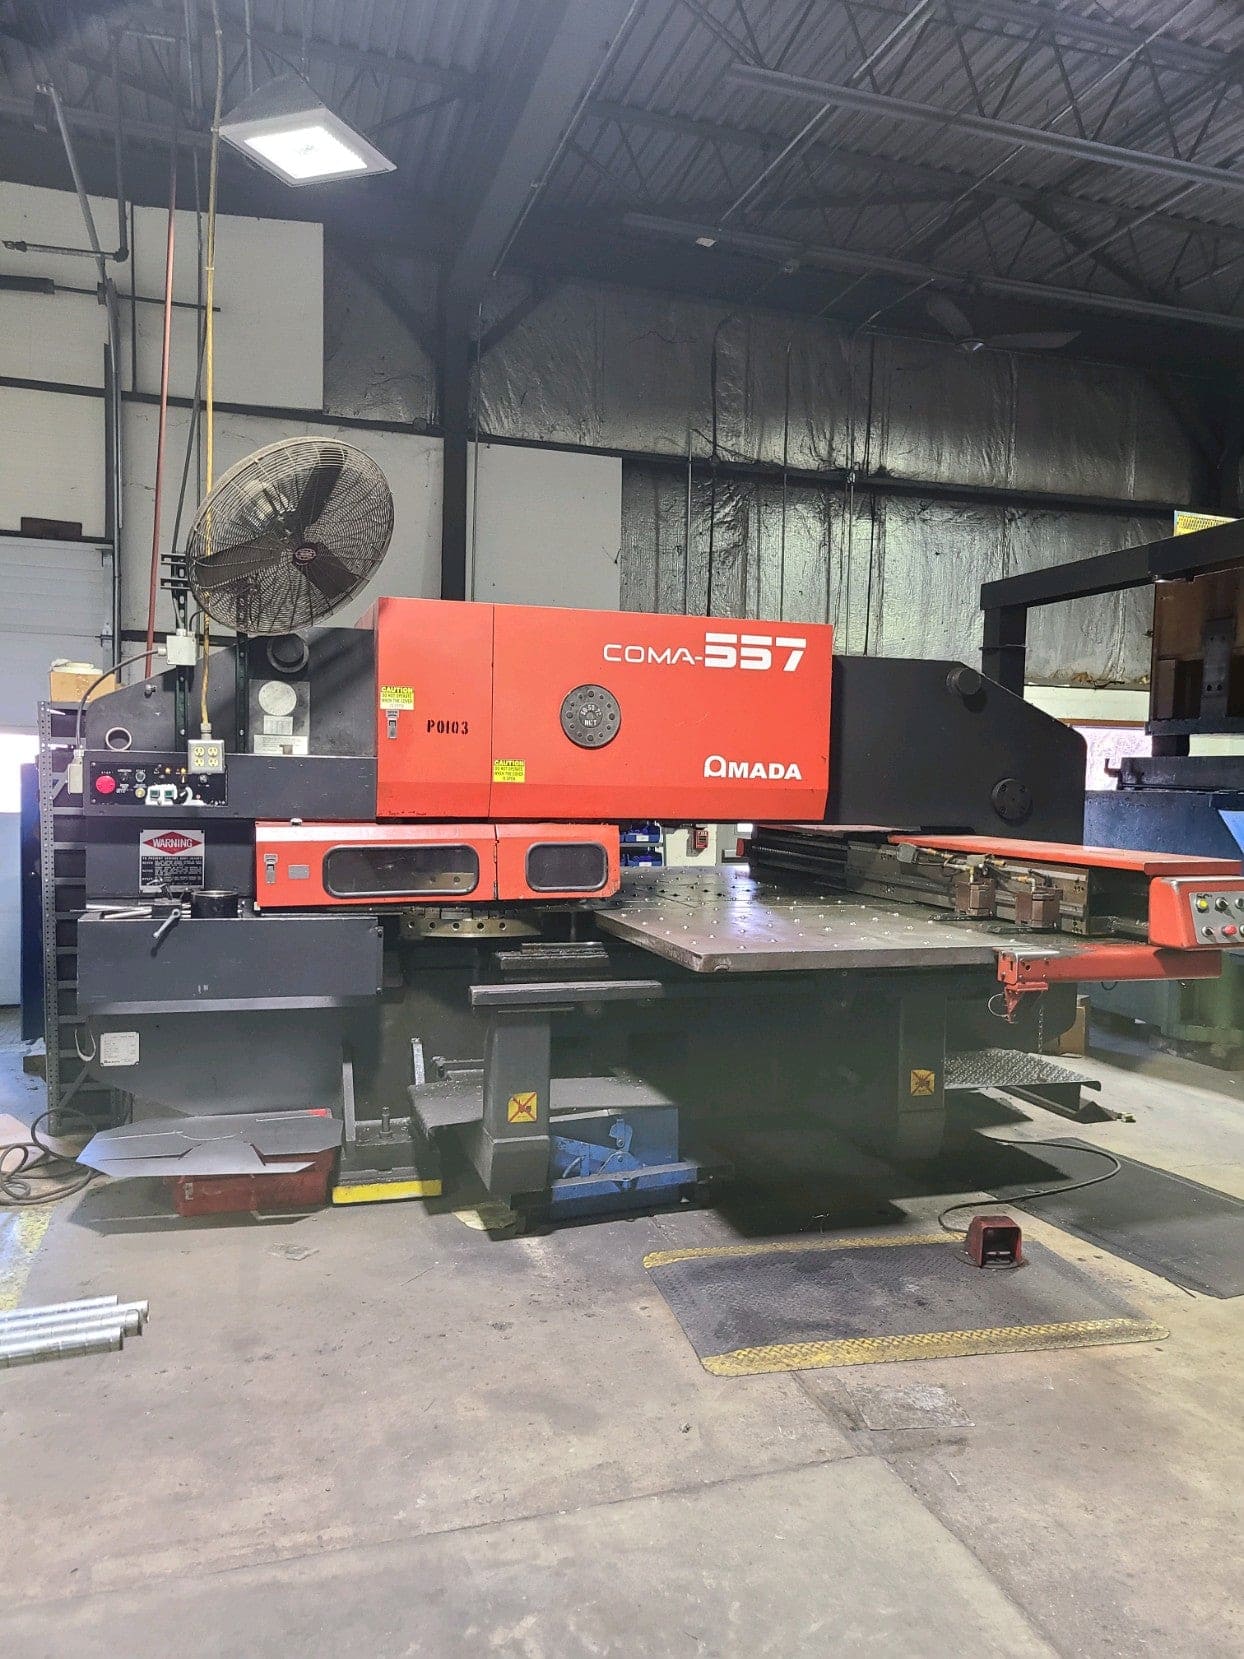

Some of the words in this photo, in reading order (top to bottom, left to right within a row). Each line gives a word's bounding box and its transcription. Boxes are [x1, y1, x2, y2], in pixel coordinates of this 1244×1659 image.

[602, 632, 807, 672] COMA-557
[703, 755, 803, 780] AMADA
[152, 838, 193, 848] WARNING
